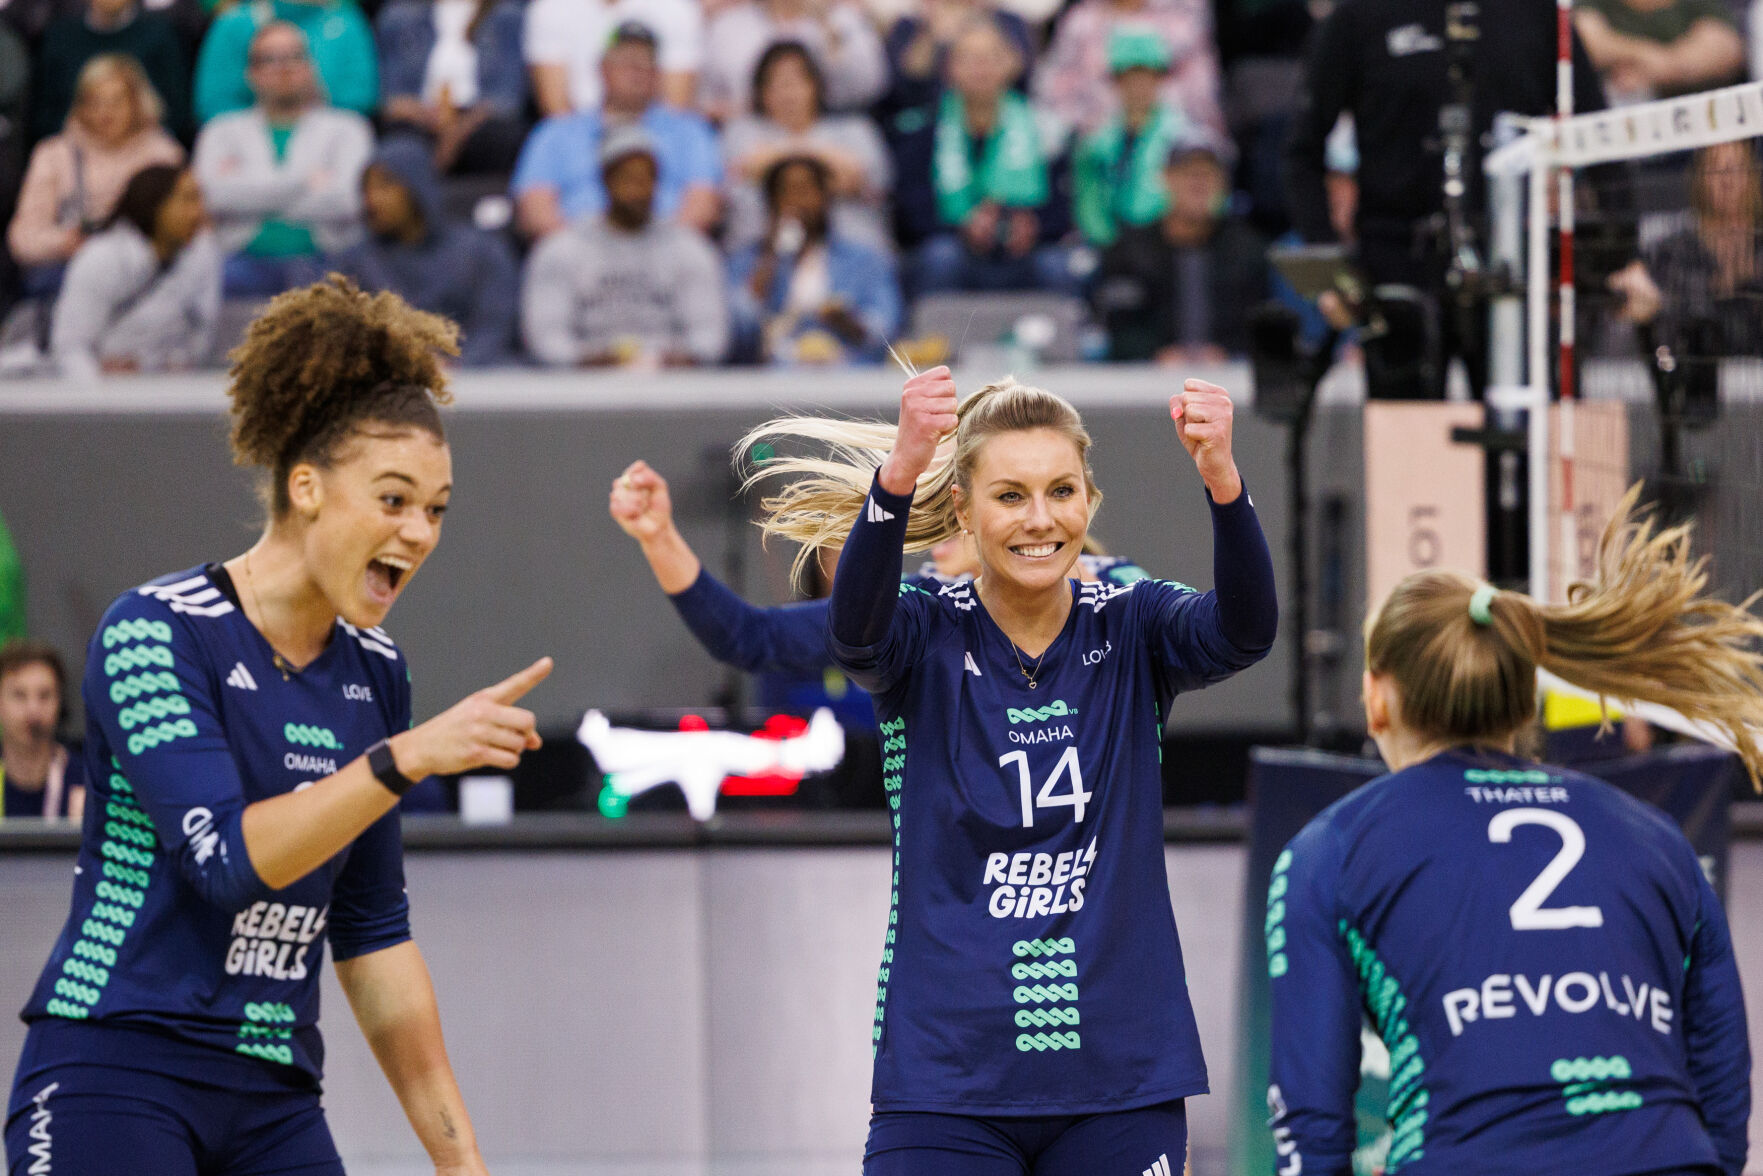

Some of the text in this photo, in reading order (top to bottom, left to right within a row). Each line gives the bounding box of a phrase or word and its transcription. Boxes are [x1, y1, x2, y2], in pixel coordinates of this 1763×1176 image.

[284, 752, 337, 774] OMAHA
[1008, 725, 1074, 745] OMAHA
[999, 746, 1092, 828] 14
[1464, 786, 1570, 803] THATER
[1487, 807, 1604, 931] 2
[1442, 971, 1674, 1037] REVOLVE
[27, 1081, 60, 1176] MAHA
